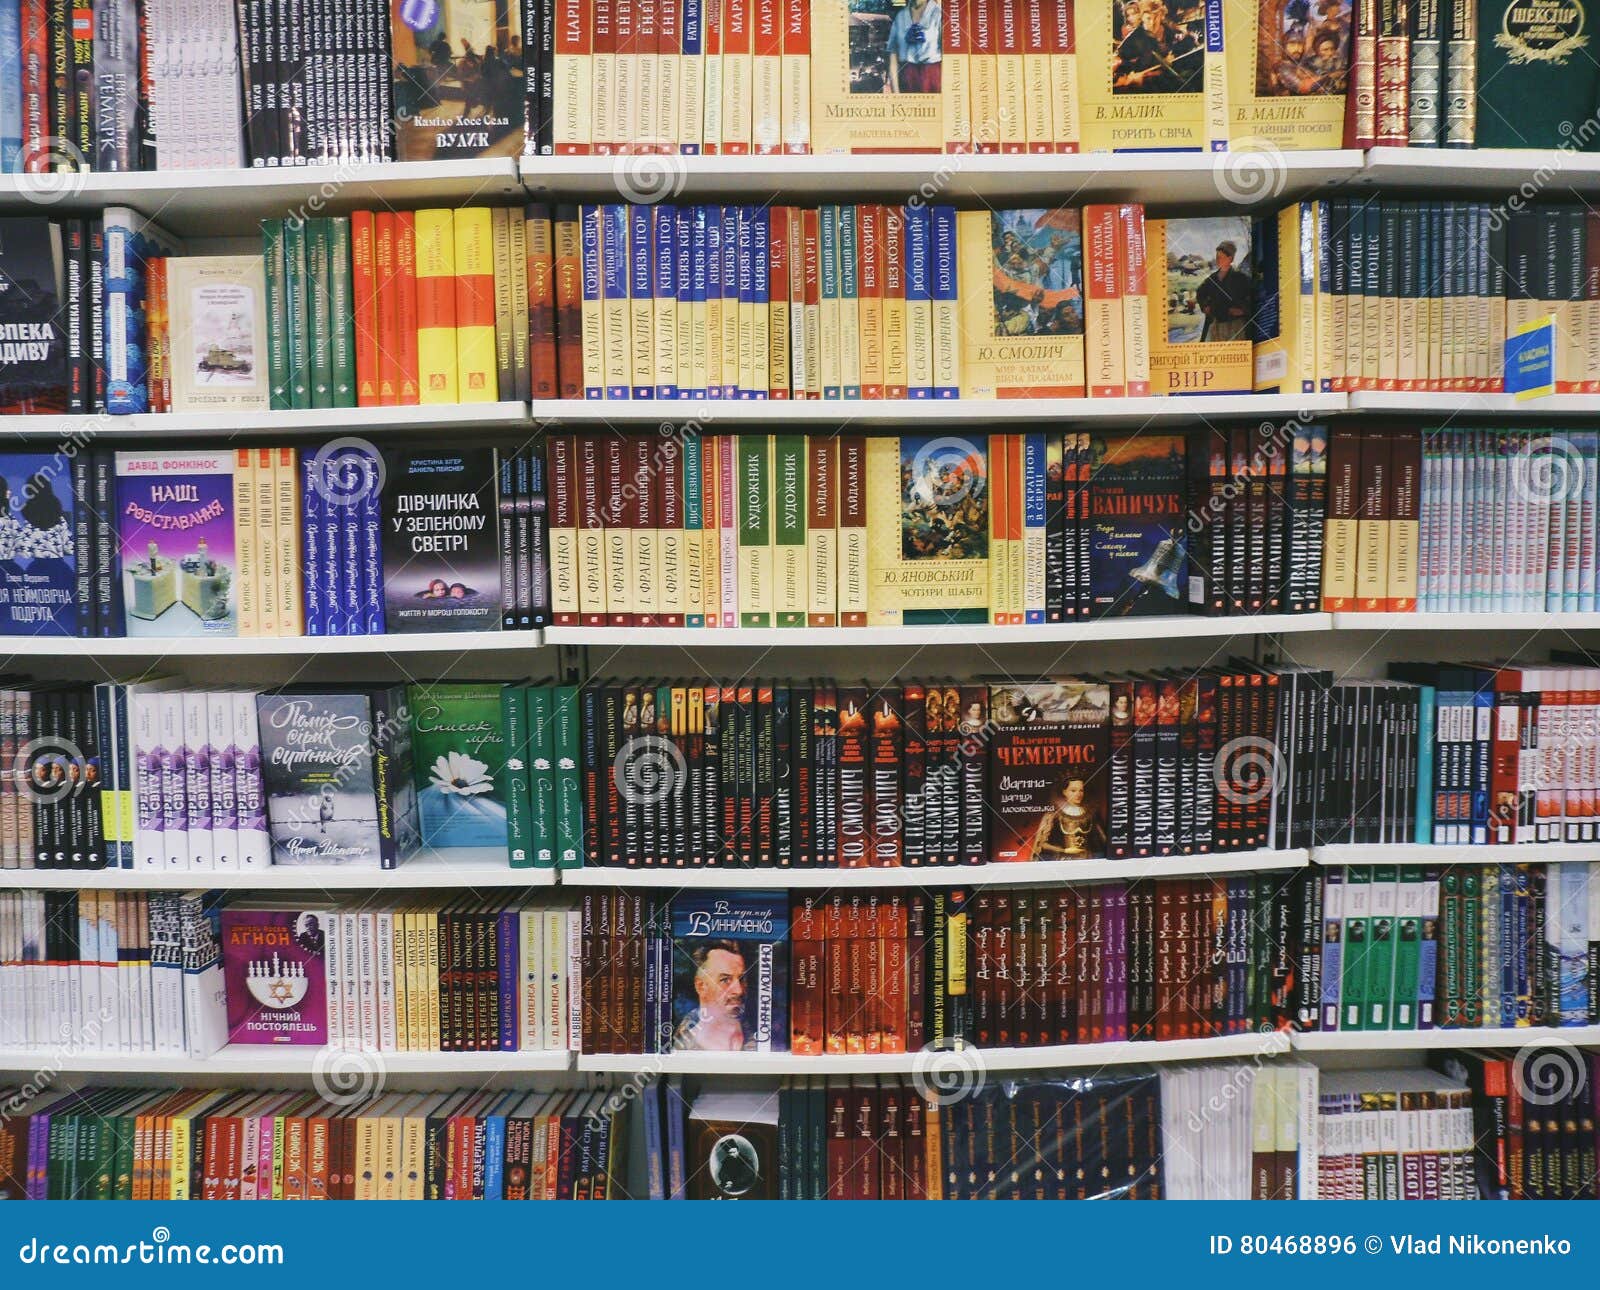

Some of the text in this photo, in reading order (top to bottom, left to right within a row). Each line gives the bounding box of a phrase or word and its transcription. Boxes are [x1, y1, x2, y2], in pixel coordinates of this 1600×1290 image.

[100, 74, 115, 152] РЕМАРК
[826, 104, 885, 117] Микола
[1096, 105, 1165, 120] В. МАЛИК
[1112, 128, 1156, 139] ГОРИТЬ
[1236, 106, 1306, 120] В. МАЛИК
[436, 132, 489, 148] ВУЛИК
[636, 248, 648, 291] КНЯЗЬ
[660, 247, 672, 290] КНЯЗЬ
[754, 247, 765, 292] КНЯЗЬ
[937, 215, 950, 292] ВОЛОДИМИР
[1350, 233, 1362, 287] ПРОЦЕС
[1367, 234, 1379, 289] ПРОЦЕС
[69, 304, 80, 358] НЕБЕЗПЕКА
[92, 304, 104, 359] НЕБЕЗПЕКА
[587, 312, 598, 360] МАЛИК
[634, 309, 649, 360] МАЛИК
[998, 346, 1064, 360] СМОЛИЧ
[151, 484, 199, 502] НАШІ
[397, 493, 479, 513] ДІВЧИНКА
[556, 440, 568, 524] УКРАДЕНЕ ЩАСТЯ
[747, 453, 761, 530] ХУДОЖНИК
[783, 453, 798, 530] ХУДОЖНИК
[815, 448, 828, 517] ГАЙДАМАКИ
[848, 447, 860, 516] ГАЙДАМАКИ
[125, 499, 225, 531] РОЗСТАВАННЯ
[392, 515, 486, 532] У ЗЕЛЕНОМУ
[411, 535, 468, 552] СВЕТРІ
[556, 536, 569, 593] ФРАНКО
[638, 536, 651, 594] ФРАНКО
[664, 536, 677, 594] ФРАНКО
[901, 568, 974, 582] ЯНОВСЬКИЙ
[997, 745, 1096, 766] ЧЕМЕРИС
[841, 768, 865, 836] СМОЛИЧ
[875, 769, 898, 836] СМОЛИЧ
[964, 762, 983, 837] ЧЕМЕРИС
[1110, 755, 1128, 829] ЧЕМЕРИС
[1157, 757, 1176, 832] ЧЕМЕРИС
[1197, 752, 1215, 826] ЧЕМЕРИС
[231, 932, 289, 945] АГНОН
[247, 1022, 317, 1032] ПОСТОЯЛЕЦЬ
[260, 1011, 300, 1021] НІЧНИЙ
[473, 1124, 485, 1186] ФАЗЕРЛАНД
